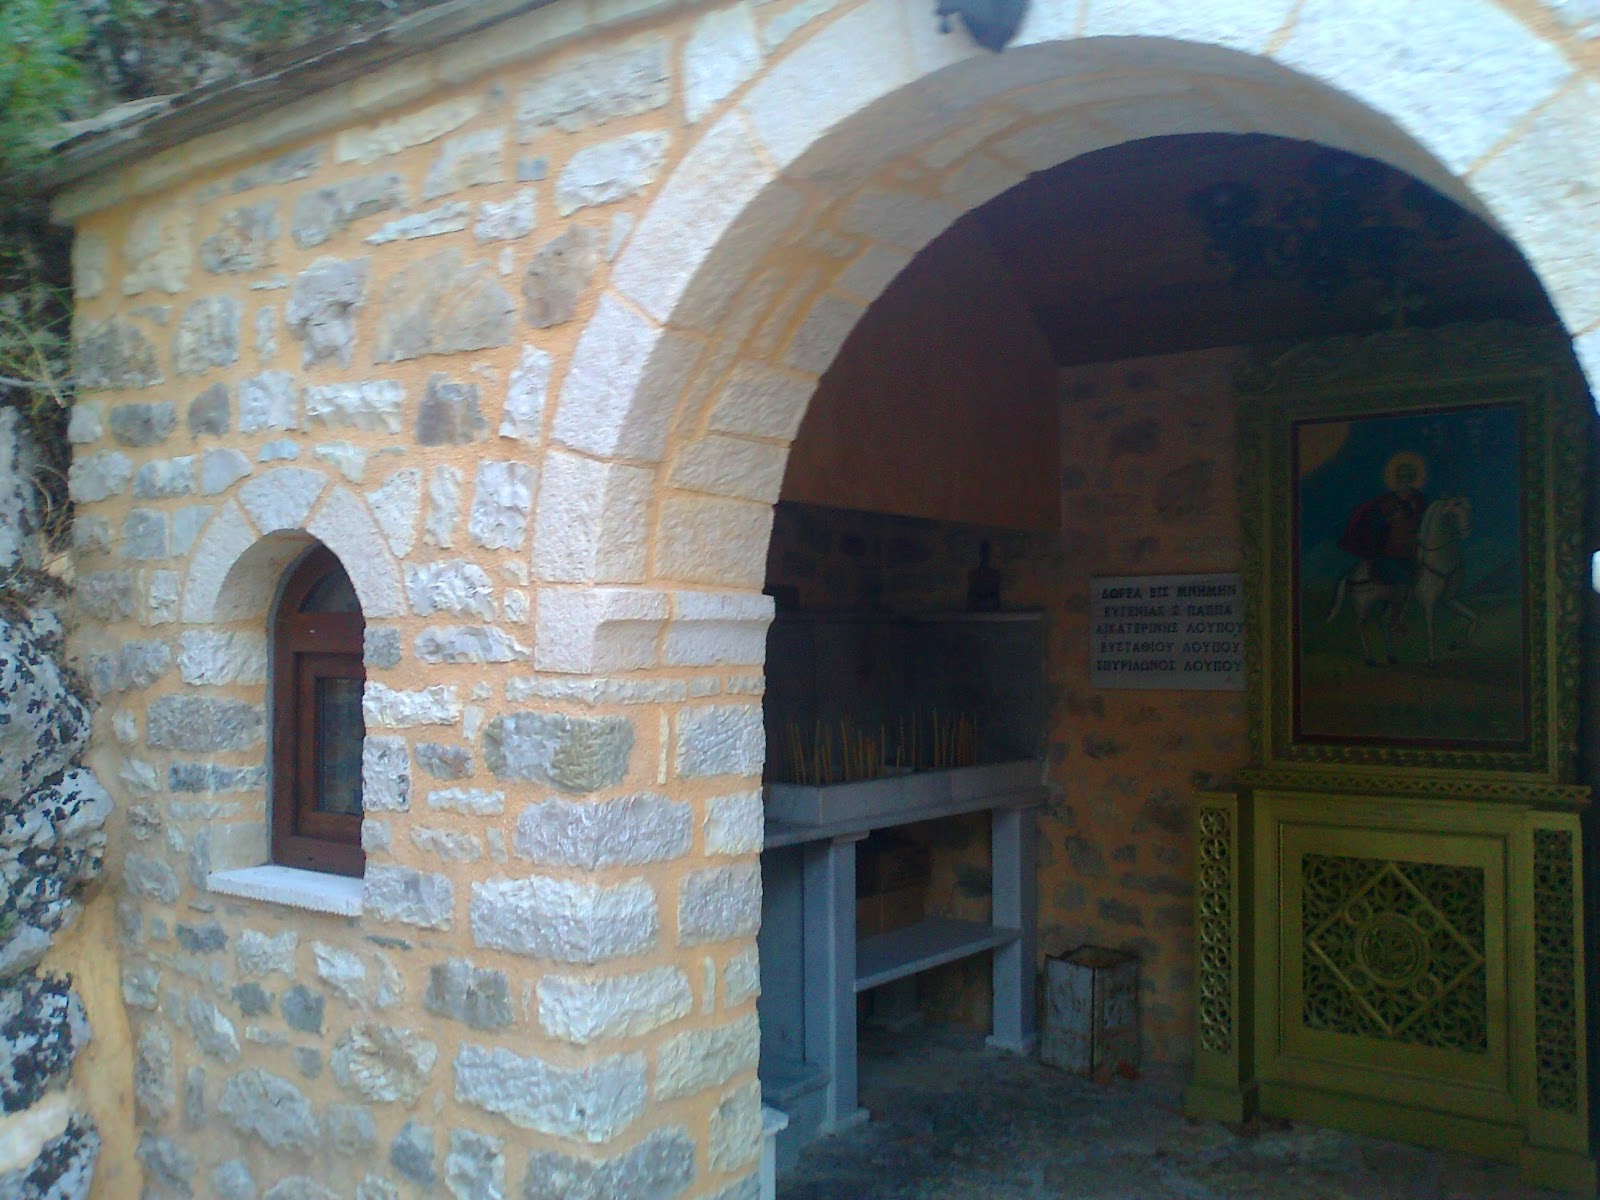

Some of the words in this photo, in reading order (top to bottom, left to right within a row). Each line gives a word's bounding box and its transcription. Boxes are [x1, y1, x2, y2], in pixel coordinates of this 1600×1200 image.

[1101, 586, 1143, 599] ΔΩΡΕΑ
[1150, 586, 1168, 598] ΕΙΣ
[1104, 605, 1164, 617] ΕΥΓΕΝΙΑΣ
[1187, 604, 1233, 616] ΠΑΠΠΑ
[1096, 622, 1179, 634] ΑΙΚΑΤΕΡΙΝΗΣ
[1187, 621, 1245, 633] ΛΟΥΠΟΥ
[1101, 641, 1174, 653] ΕΥΣΤΑΘΙΟΥ
[1182, 641, 1241, 653] ΛΟΥΠΟΥ
[1096, 659, 1176, 672] ΣΠΥΡΙΔΩΝΟΣ
[1184, 659, 1242, 672] ΛΟΥΠΟΥ
